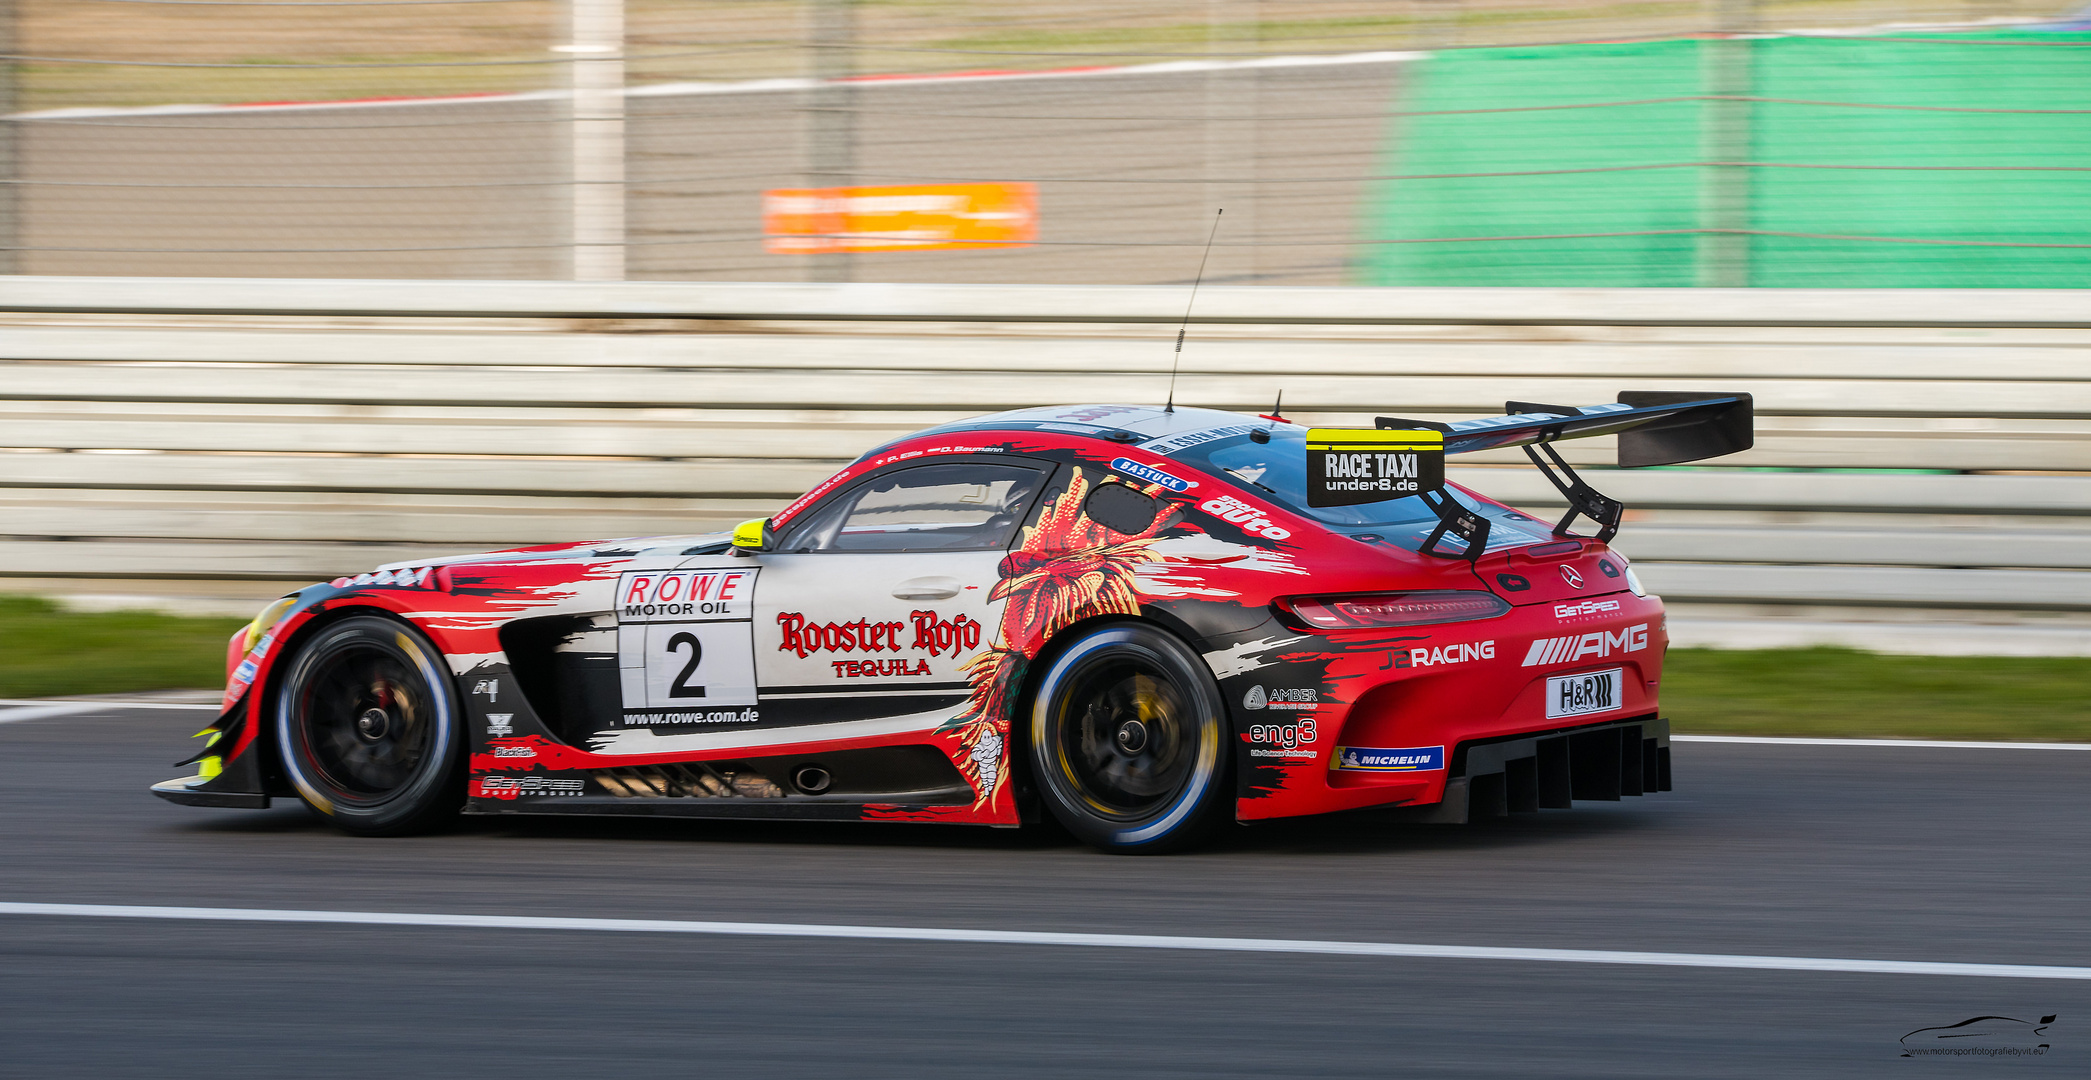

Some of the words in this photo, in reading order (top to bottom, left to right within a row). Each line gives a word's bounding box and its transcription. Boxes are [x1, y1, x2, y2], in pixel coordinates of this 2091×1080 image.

[1119, 461, 1182, 489] BASTUCK
[1325, 453, 1372, 478] RACE
[1375, 453, 1418, 478] TAXI
[1326, 478, 1418, 491] under8.de
[1217, 495, 1267, 517] sport
[1201, 500, 1291, 540] auto
[627, 574, 742, 604] ROWE
[626, 604, 693, 616] MOTOR
[701, 602, 730, 614] OIL
[777, 611, 905, 658] Rooster
[909, 609, 981, 659] Rojo
[1572, 623, 1648, 661] AMG
[666, 631, 706, 699] 2
[832, 659, 932, 678] TEQUILA
[1379, 640, 1495, 671] J2RACING
[1269, 688, 1318, 702] AMBER
[1561, 677, 1595, 712] H&R
[624, 707, 759, 725] www.rowe.com.de
[1249, 718, 1317, 749] eng3
[1284, 750, 1317, 758] Technology
[1361, 754, 1432, 765] MICHELIN
